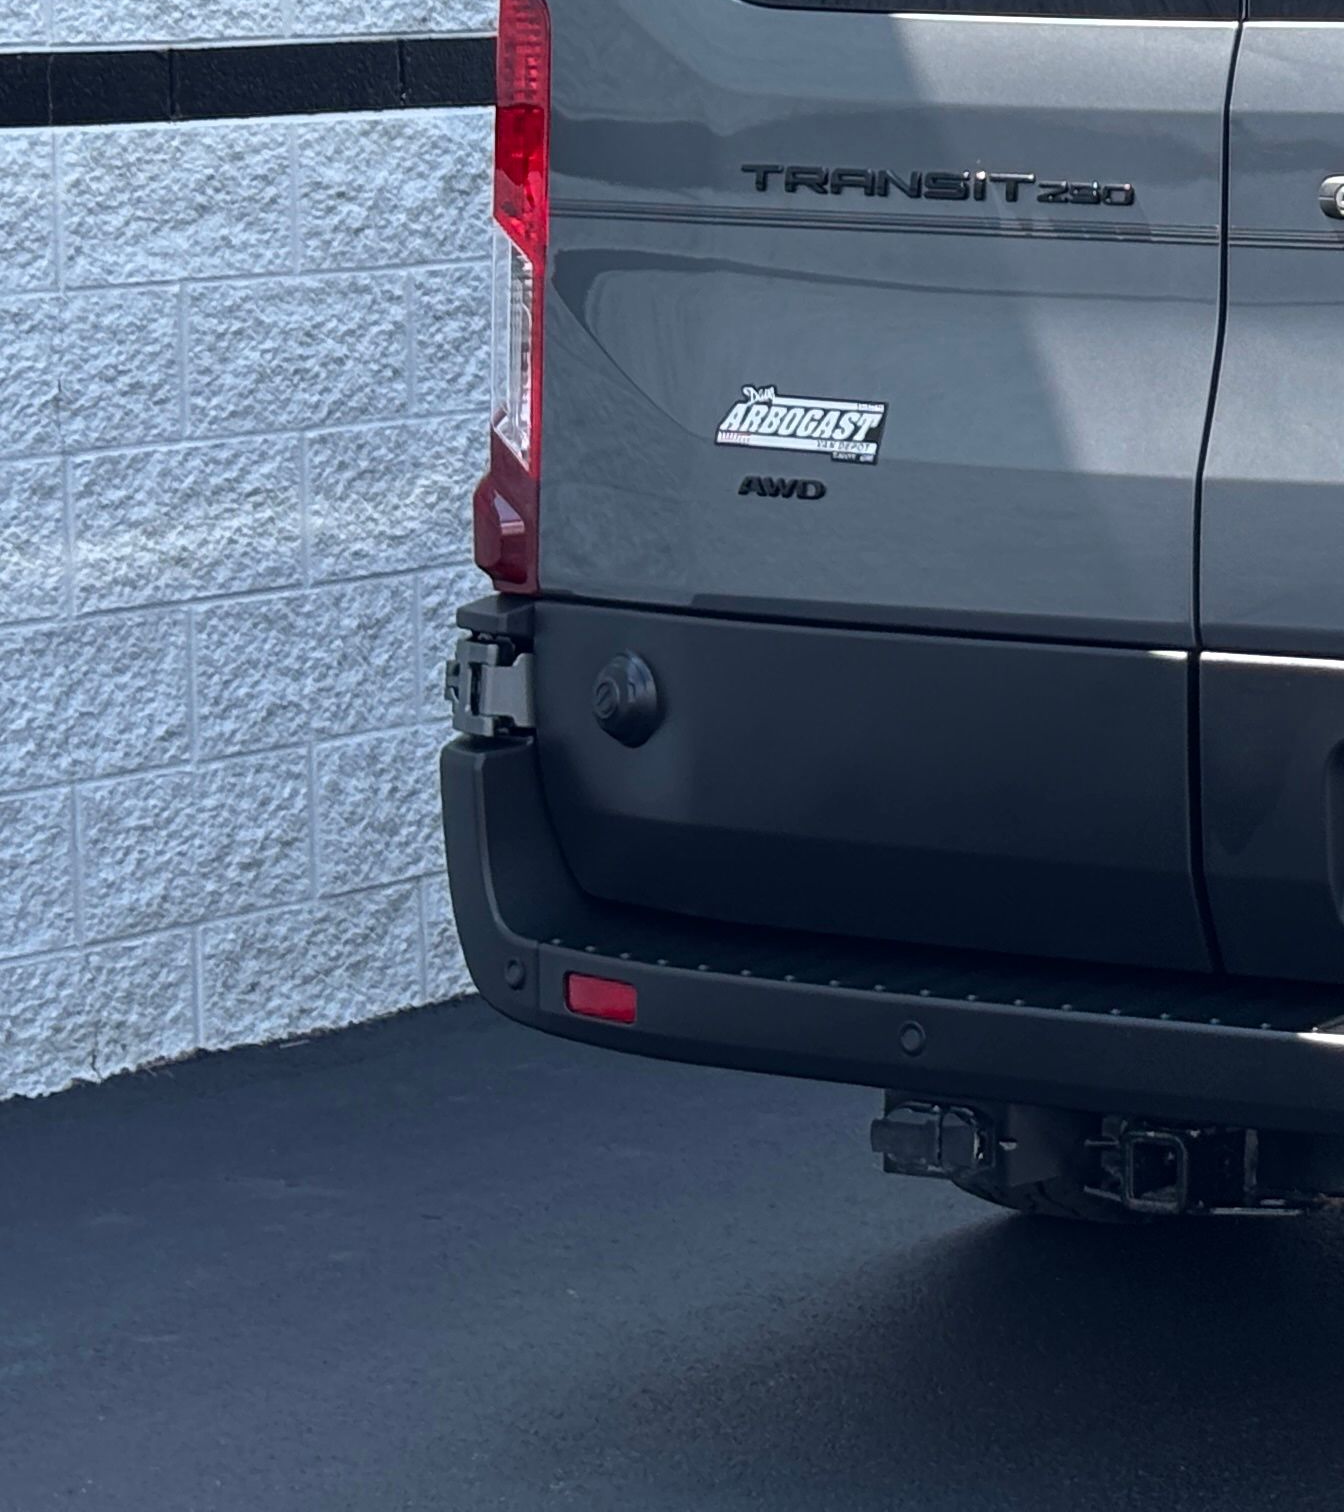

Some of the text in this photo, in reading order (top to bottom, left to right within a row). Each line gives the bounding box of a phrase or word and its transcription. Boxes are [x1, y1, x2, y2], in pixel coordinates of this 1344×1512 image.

[741, 163, 1036, 202] TRANSIT
[719, 403, 883, 441] ARBOGAST
[738, 476, 827, 500] AWD
